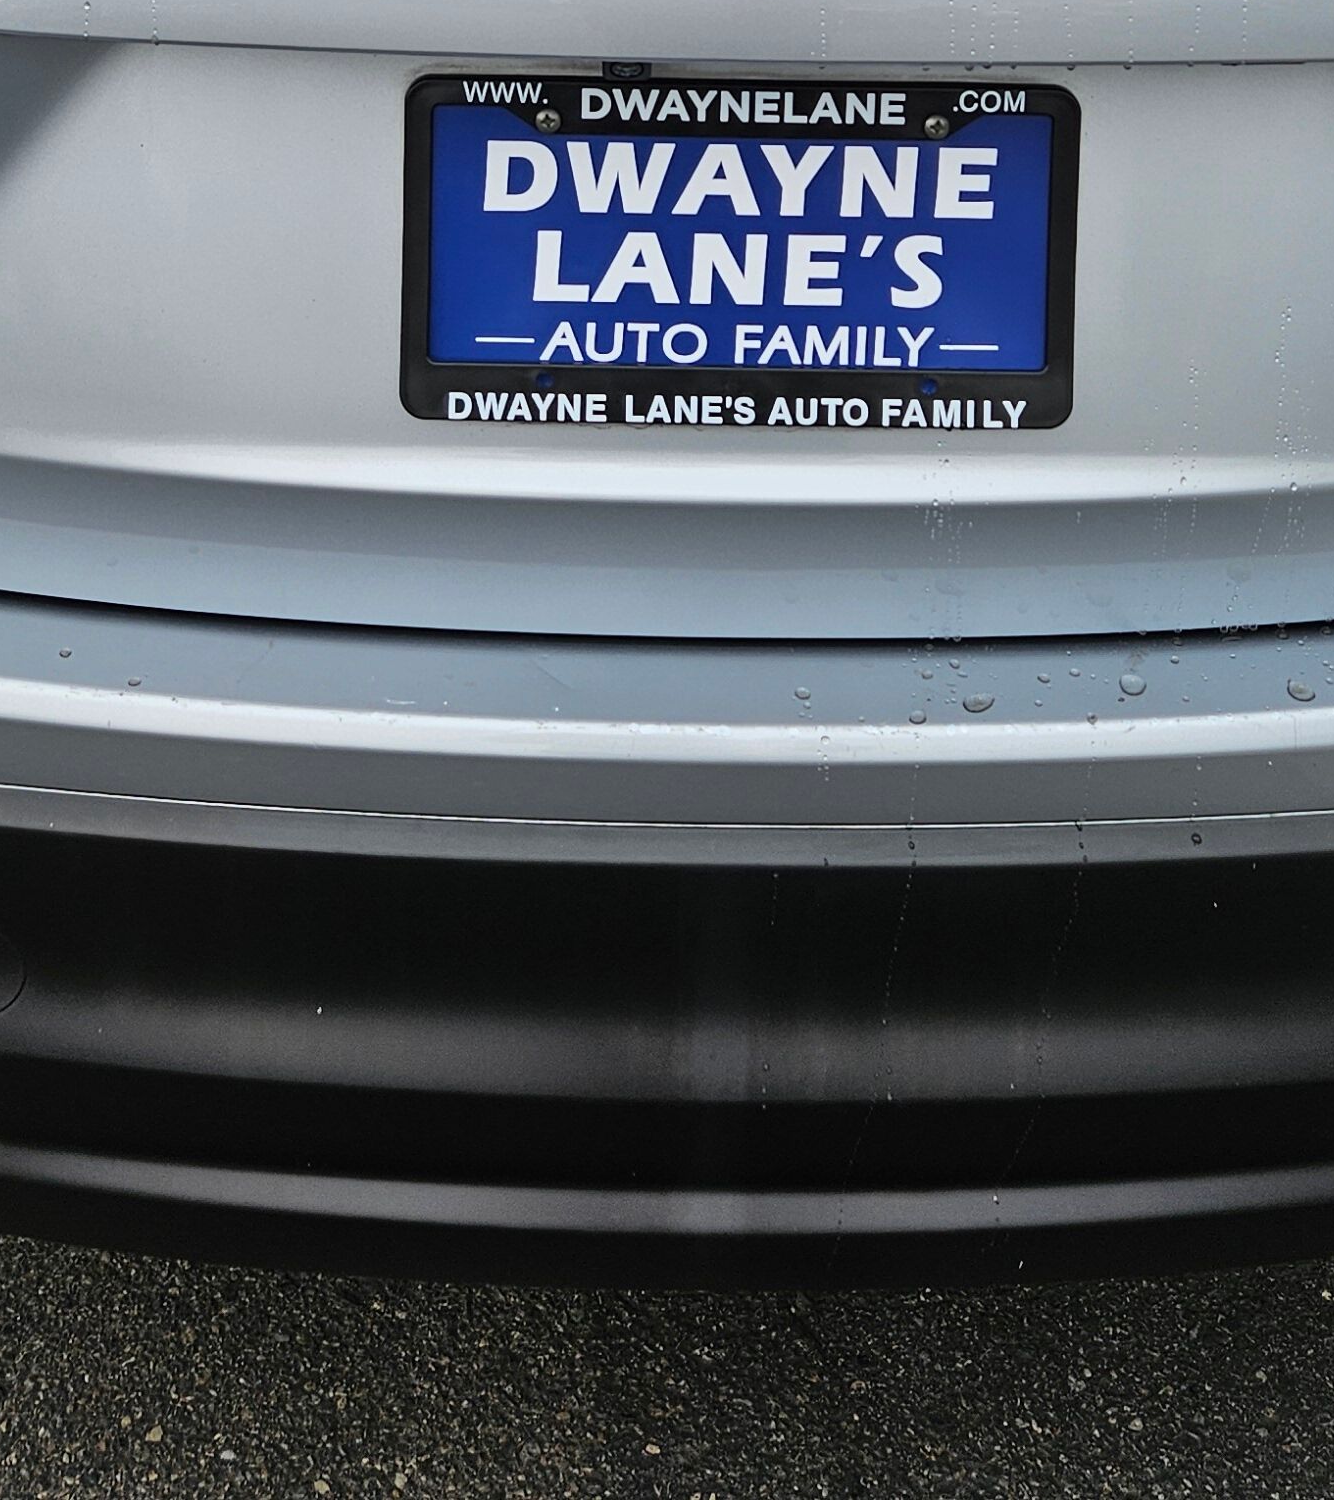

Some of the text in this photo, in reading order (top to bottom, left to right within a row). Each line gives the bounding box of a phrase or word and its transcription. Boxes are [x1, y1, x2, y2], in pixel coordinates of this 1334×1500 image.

[462, 81, 1027, 126] WWW. DWAYNELANE .COM
[482, 138, 999, 220] DWAYNE
[531, 228, 945, 310] LANE'S
[539, 320, 936, 368] AUTO FAMILY
[447, 390, 1028, 429] DWAYNE LANE'S AUTO FAMILY
